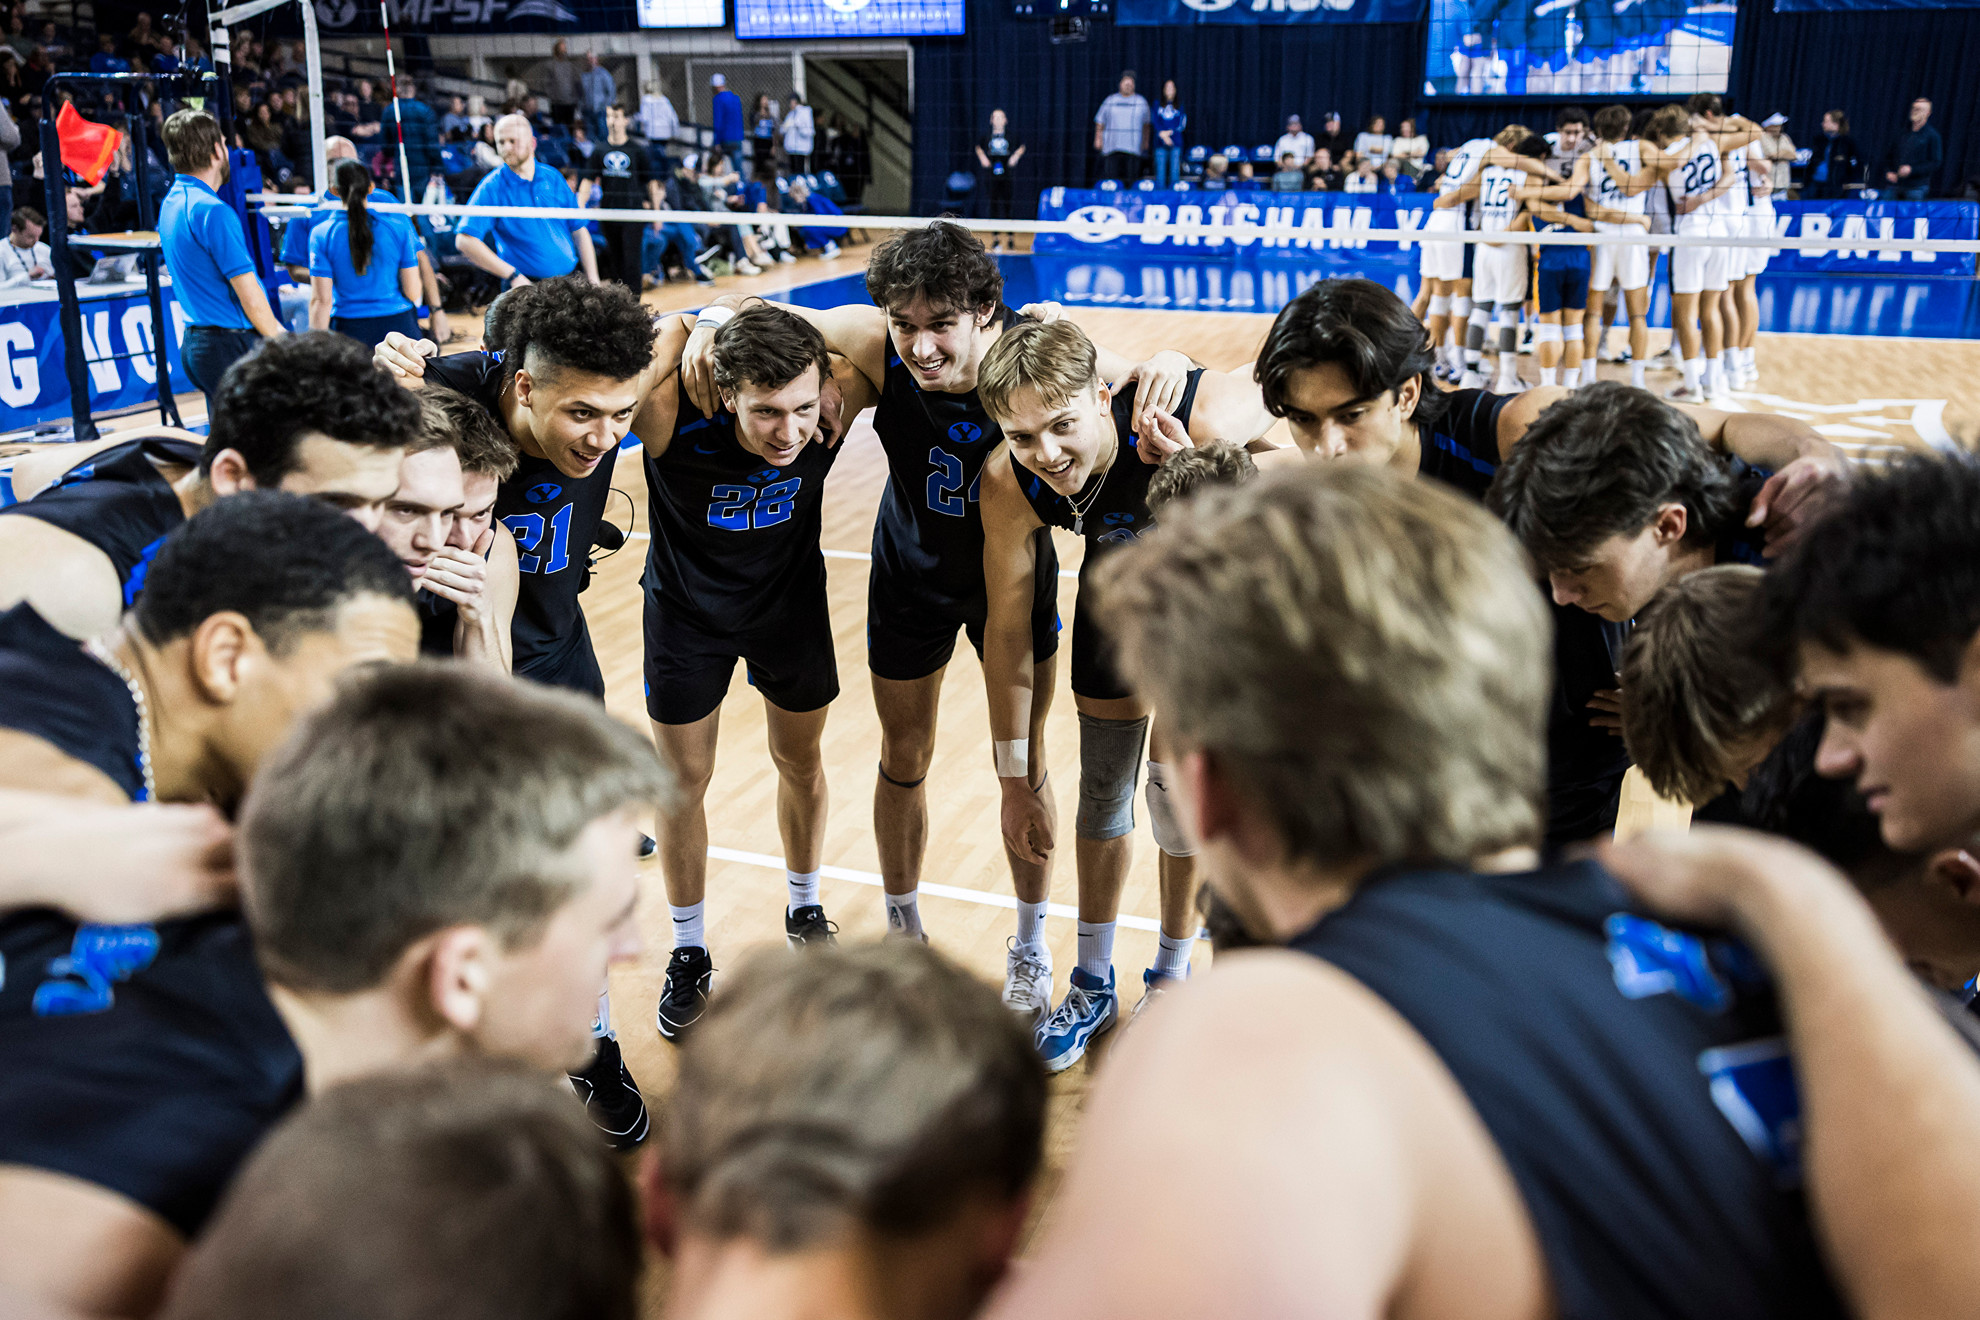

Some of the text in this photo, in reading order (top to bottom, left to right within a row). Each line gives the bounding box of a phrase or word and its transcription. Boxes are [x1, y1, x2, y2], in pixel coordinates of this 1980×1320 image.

[387, 0, 508, 24] MPSF
[1484, 177, 1512, 207] 12
[1681, 153, 1715, 193] 22
[1140, 203, 1371, 250] BRIGHAM
[707, 477, 802, 531] 22
[501, 502, 574, 575] 21
